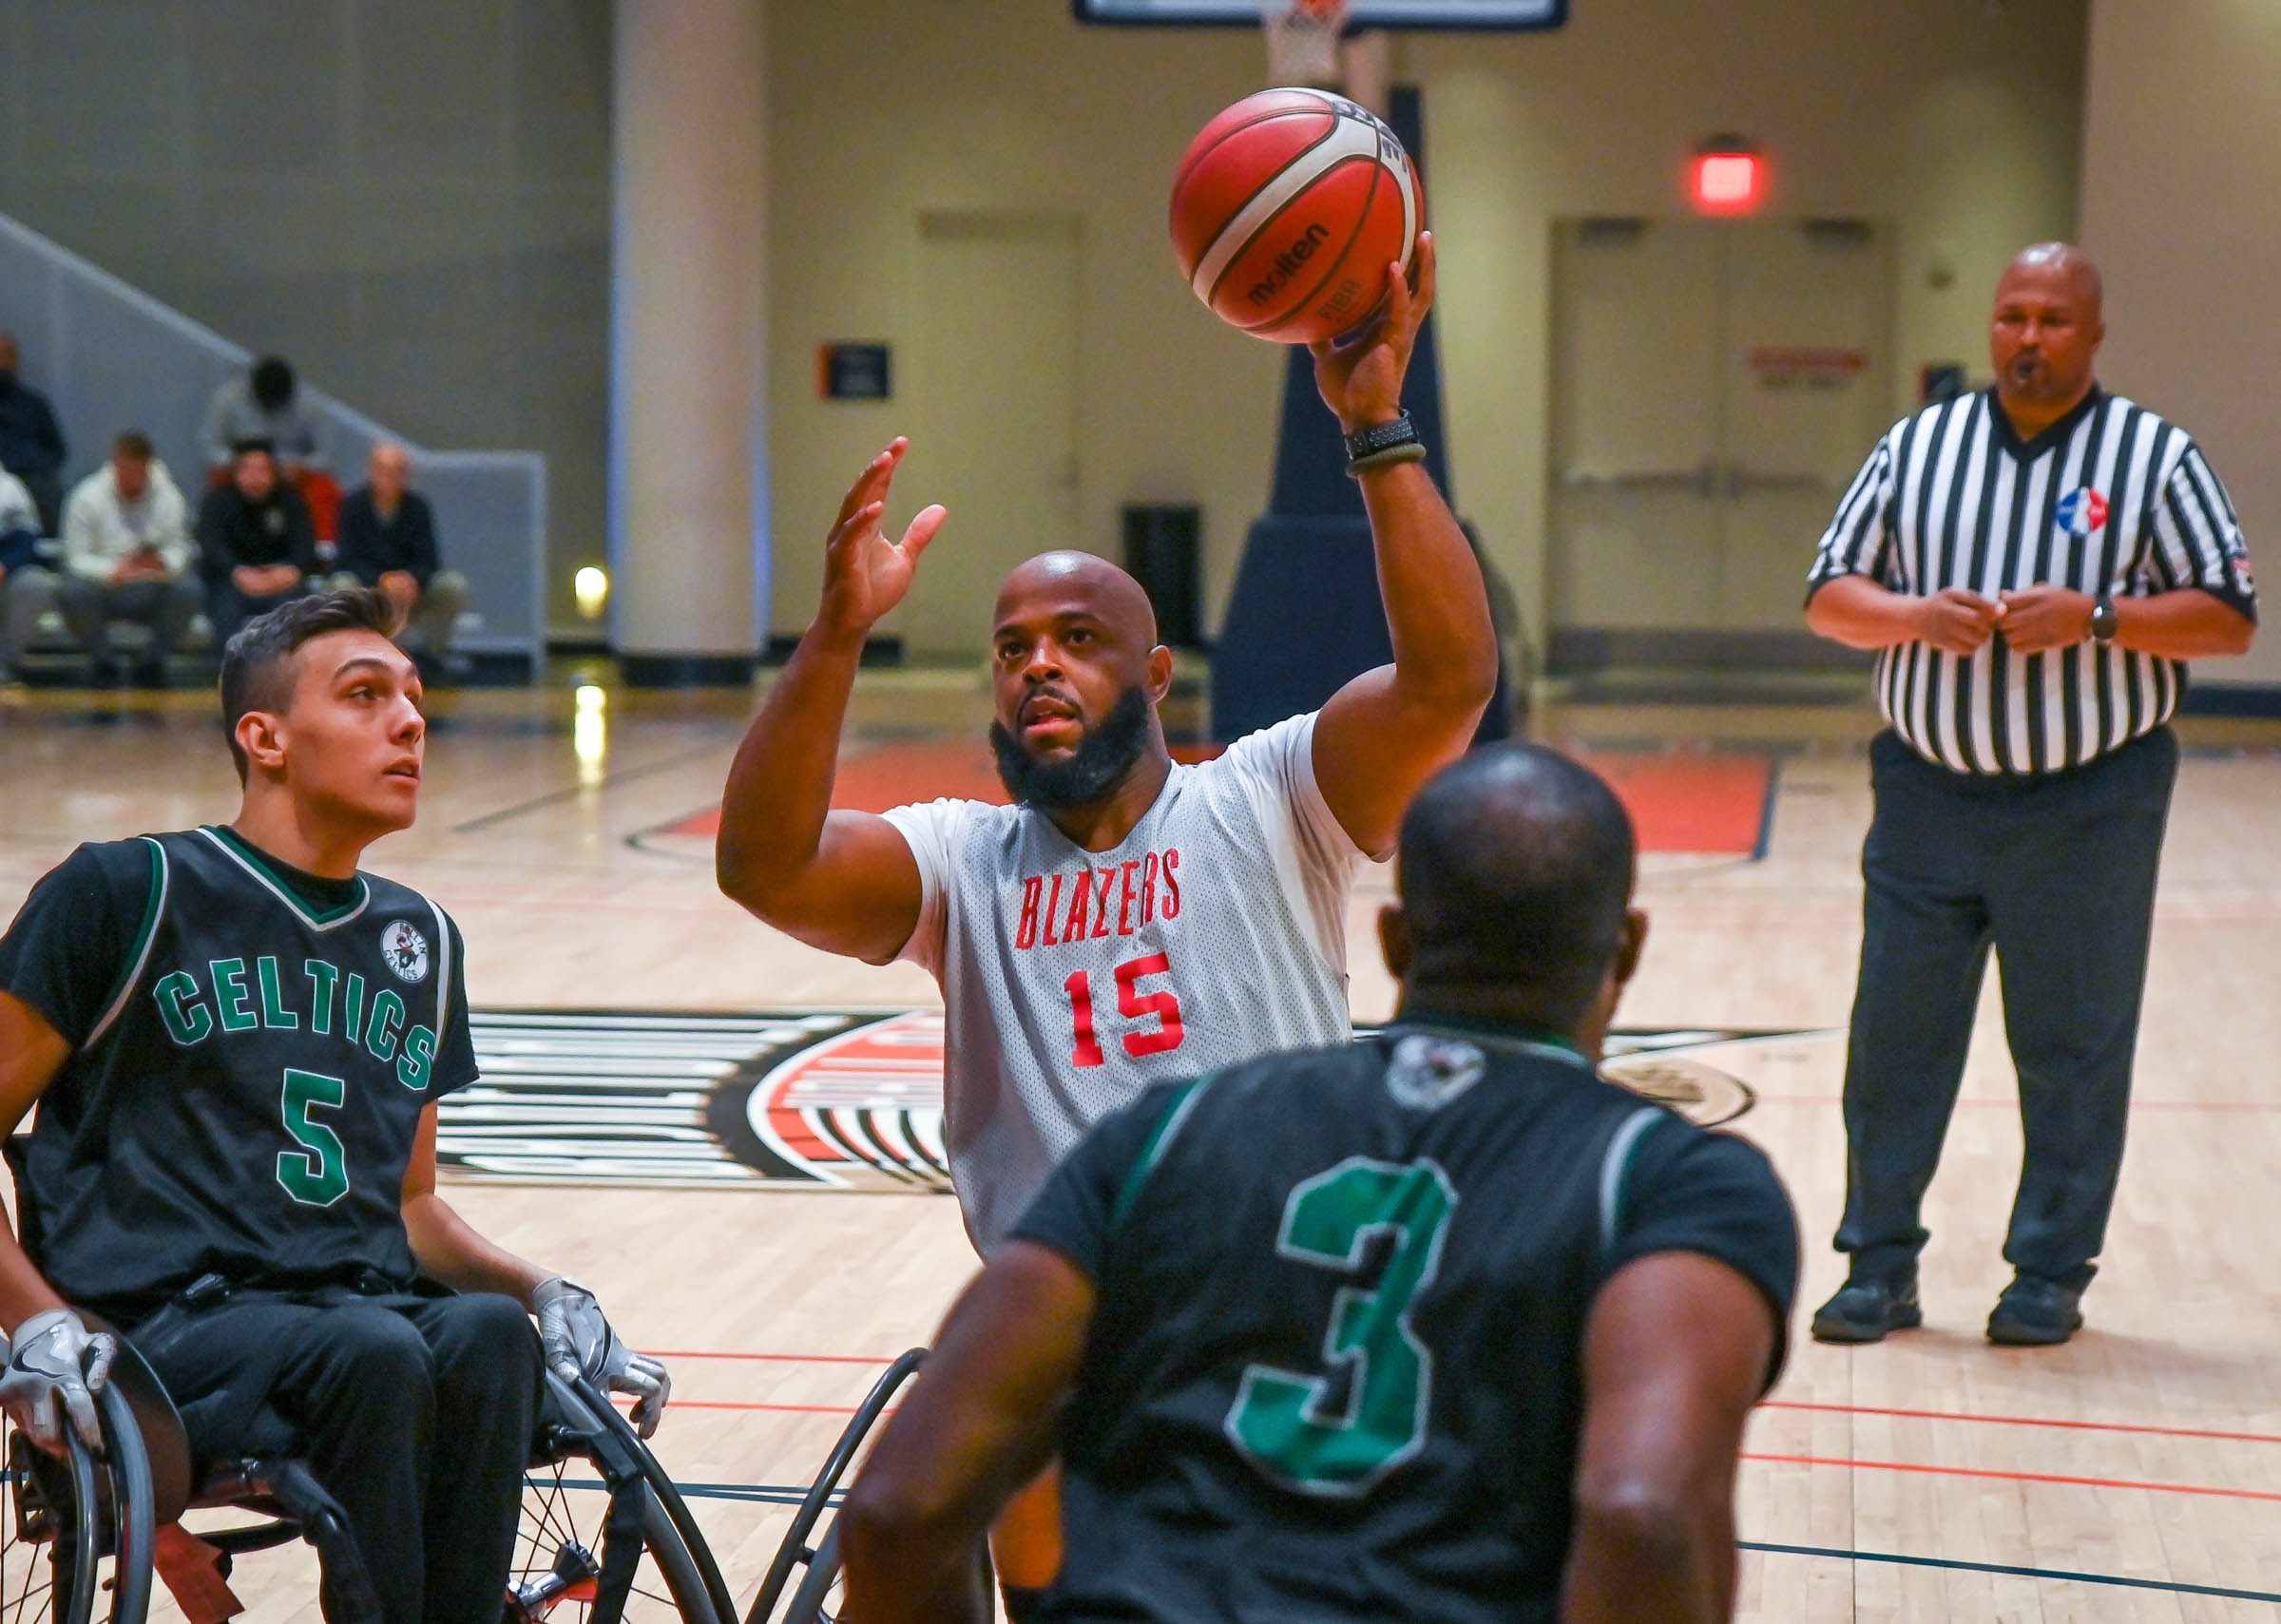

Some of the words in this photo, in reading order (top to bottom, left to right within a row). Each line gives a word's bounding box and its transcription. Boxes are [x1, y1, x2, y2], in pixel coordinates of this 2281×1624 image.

[1247, 223, 1329, 307] molten
[1015, 848, 1180, 949] BLAZERS
[153, 955, 436, 1092] CELTICS
[1064, 951, 1185, 1068] 15
[276, 1067, 349, 1208] 5
[1223, 1155, 1460, 1499] 3
